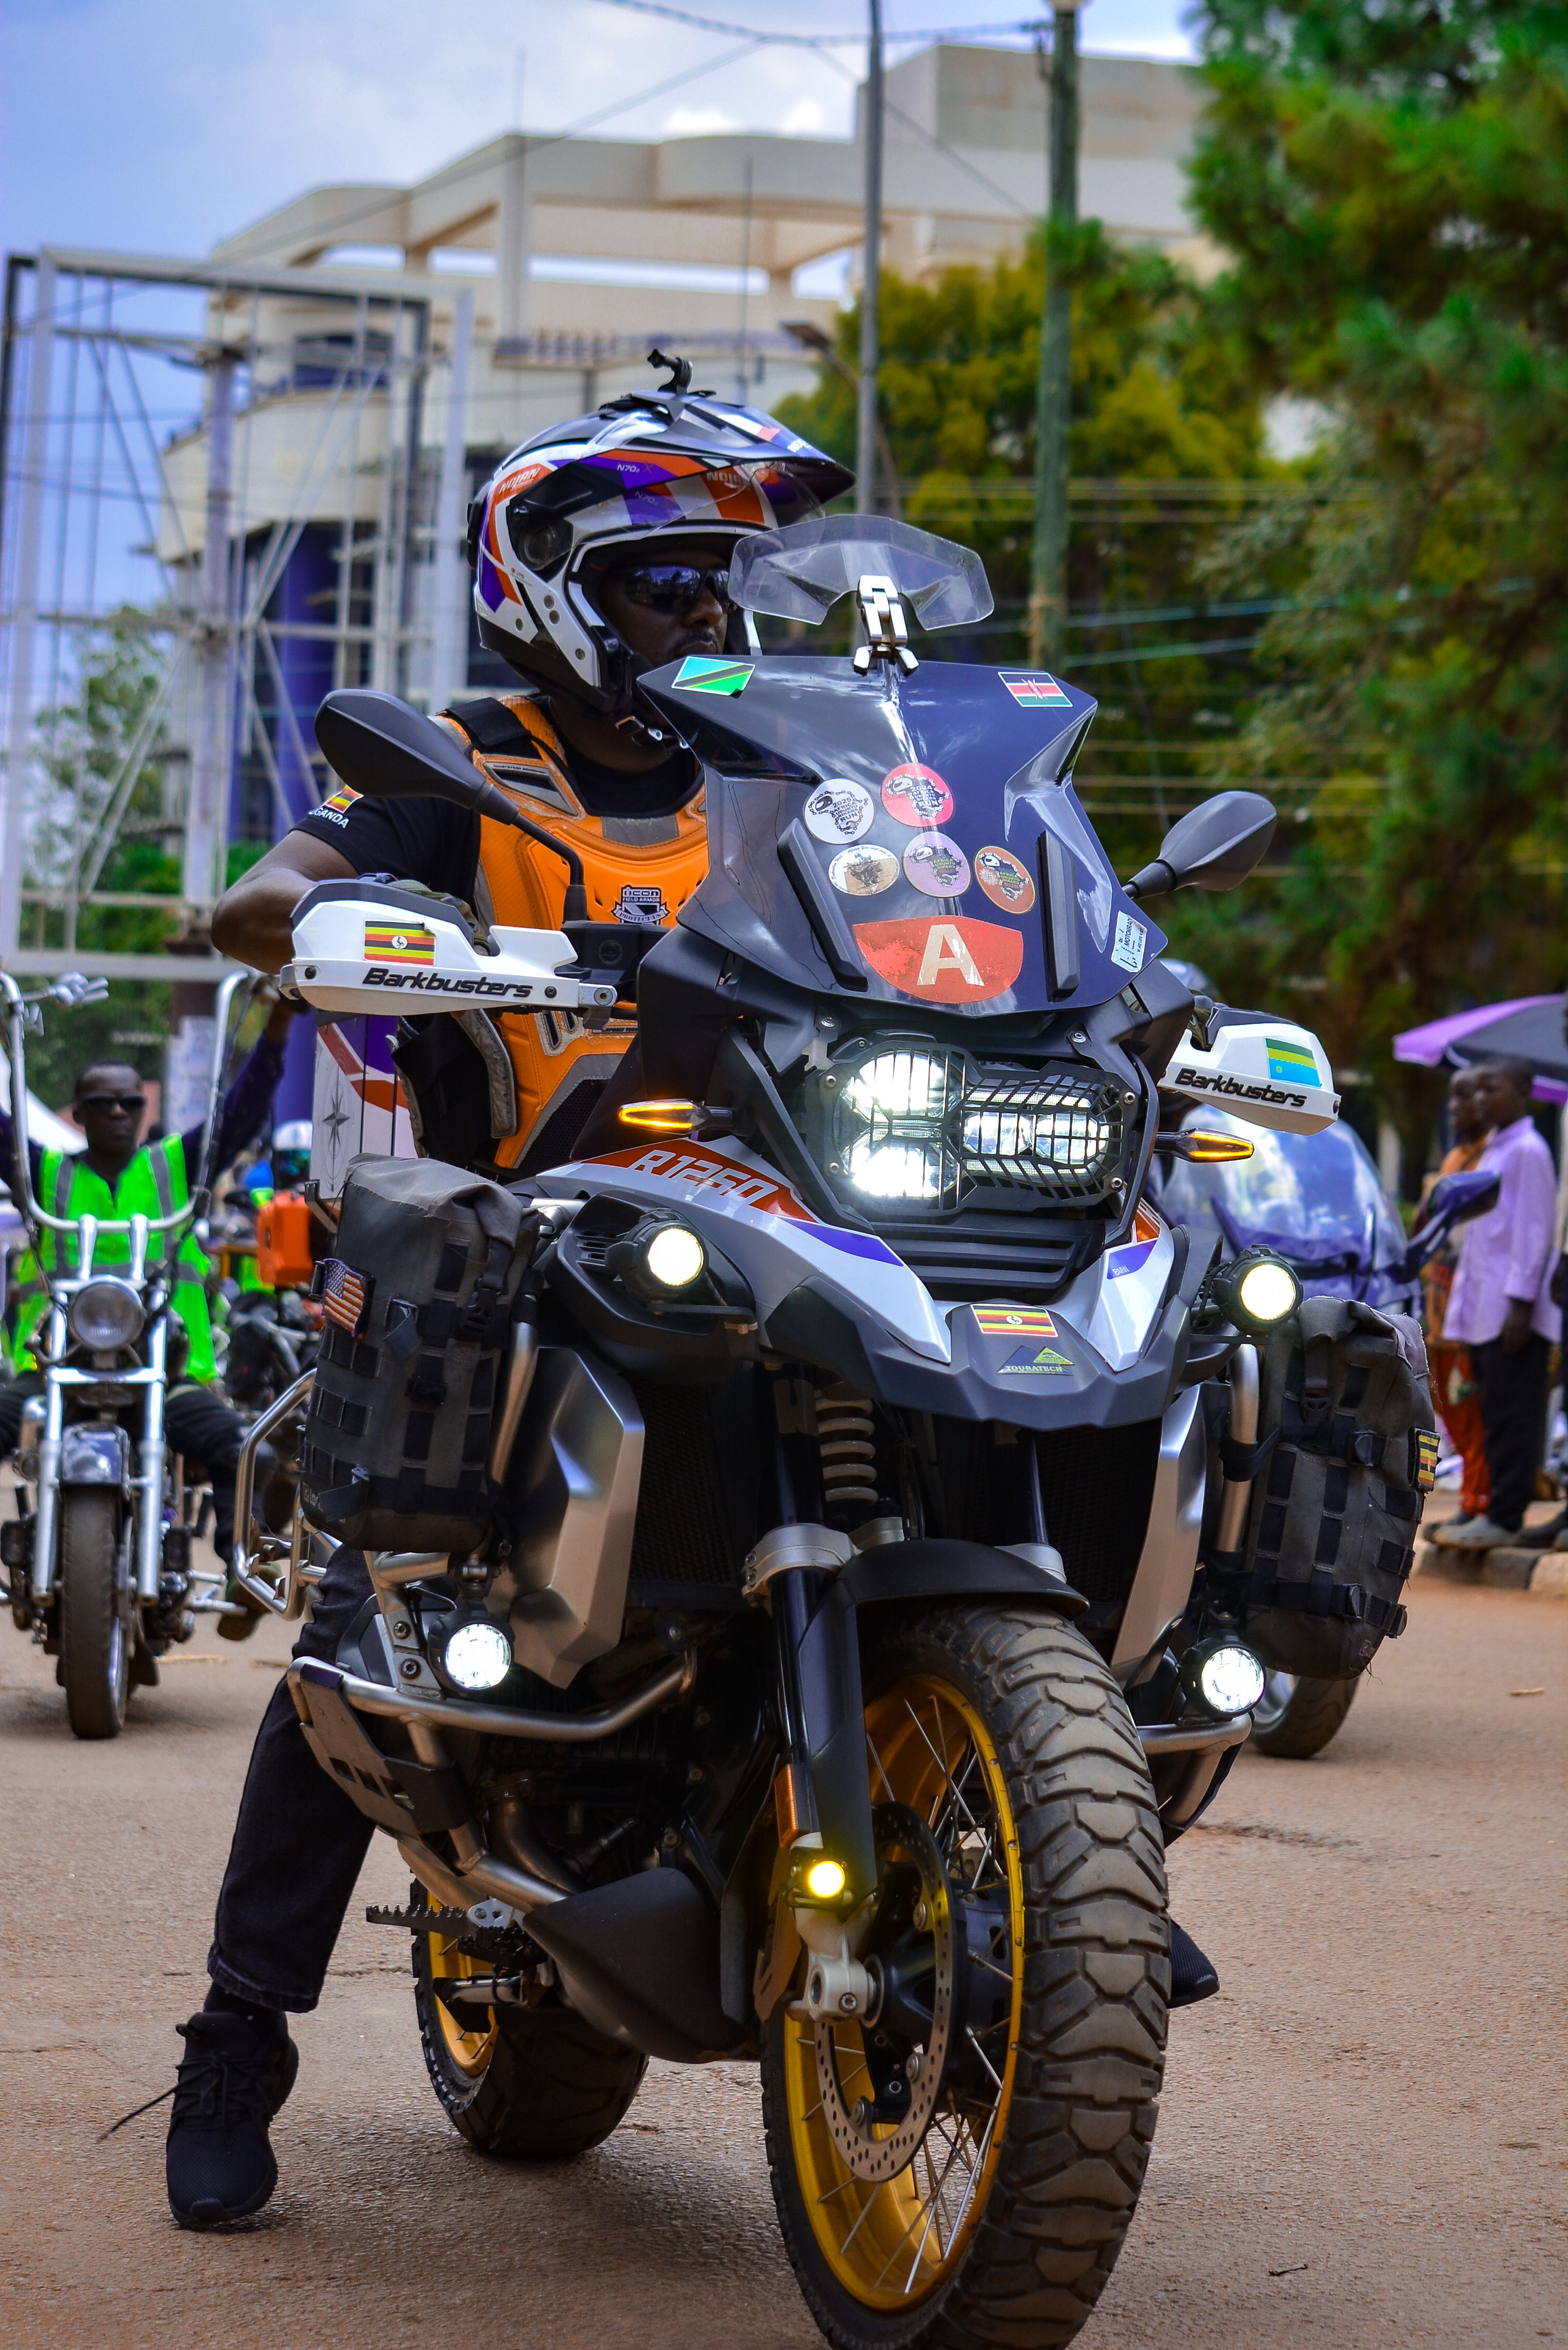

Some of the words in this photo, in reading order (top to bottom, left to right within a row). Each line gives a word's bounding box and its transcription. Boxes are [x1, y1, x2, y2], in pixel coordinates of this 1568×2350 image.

[499, 467, 541, 494] NOLAN
[833, 798, 852, 809] 2025
[834, 801, 857, 812] AFRICA
[836, 804, 858, 815] UBUNTU
[838, 808, 858, 818] BIKERS
[840, 812, 858, 822] RUN
[619, 912, 652, 921] PROTECT
[1124, 918, 1133, 947] MOTORRAD
[916, 924, 985, 986] A
[363, 967, 533, 998] Barkbusters
[1175, 1067, 1307, 1107] Barkbusters
[1112, 1265, 1130, 1275] BMW
